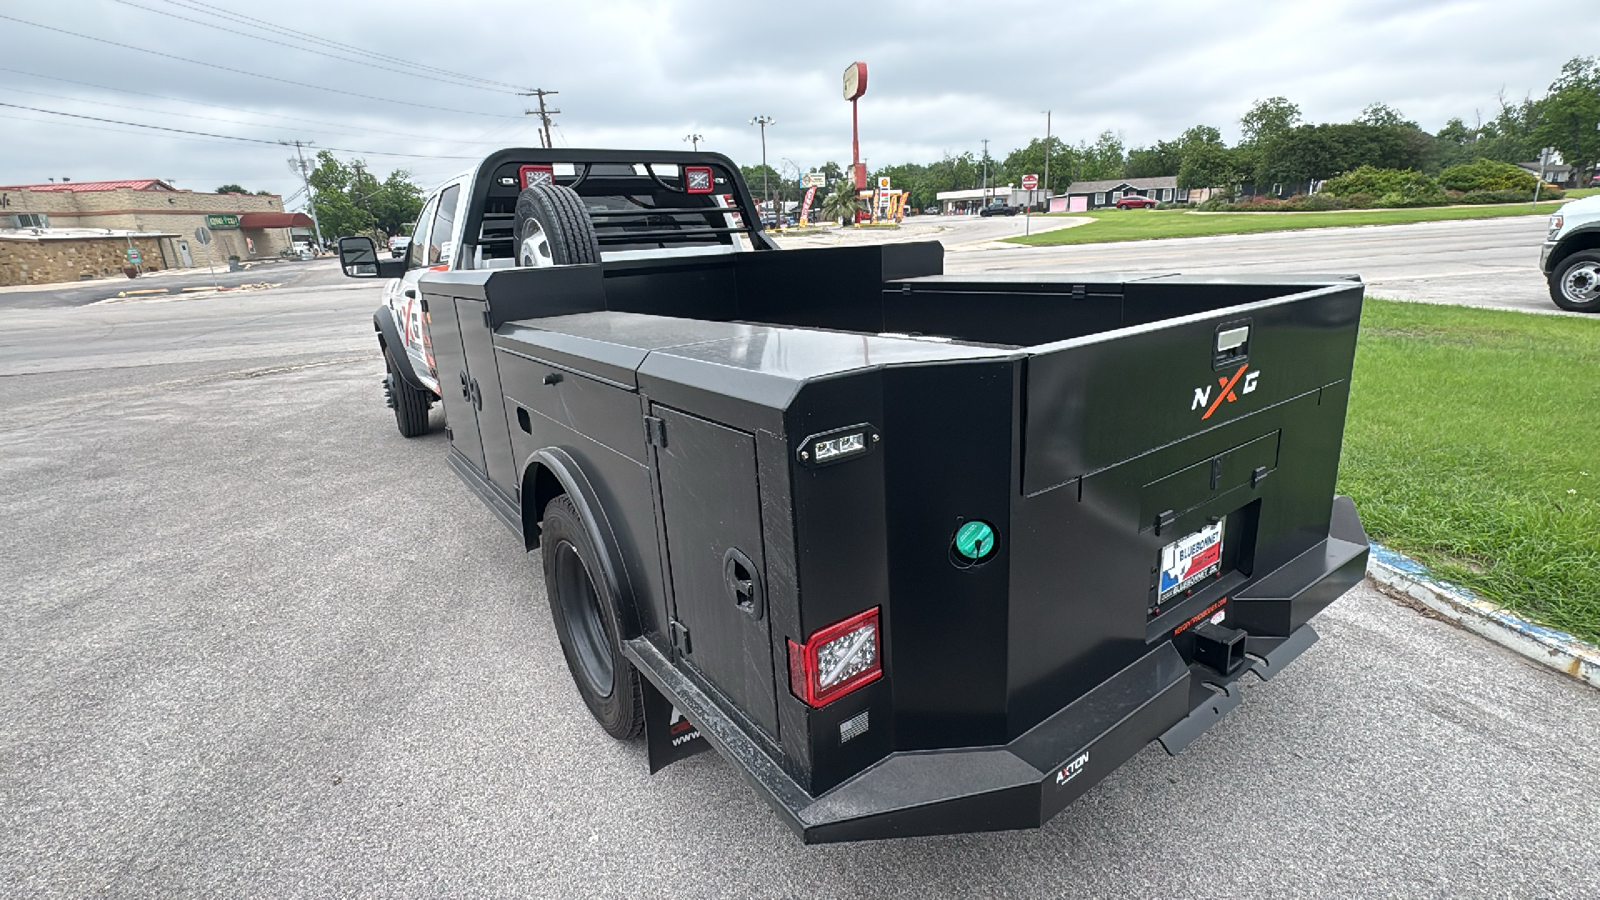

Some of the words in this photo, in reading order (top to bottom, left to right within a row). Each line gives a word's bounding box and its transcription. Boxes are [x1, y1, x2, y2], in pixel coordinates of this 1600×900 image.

[1191, 363, 1260, 420] NXG
[1180, 531, 1219, 562] BLUEBONNET
[1056, 751, 1089, 784] AXTON
